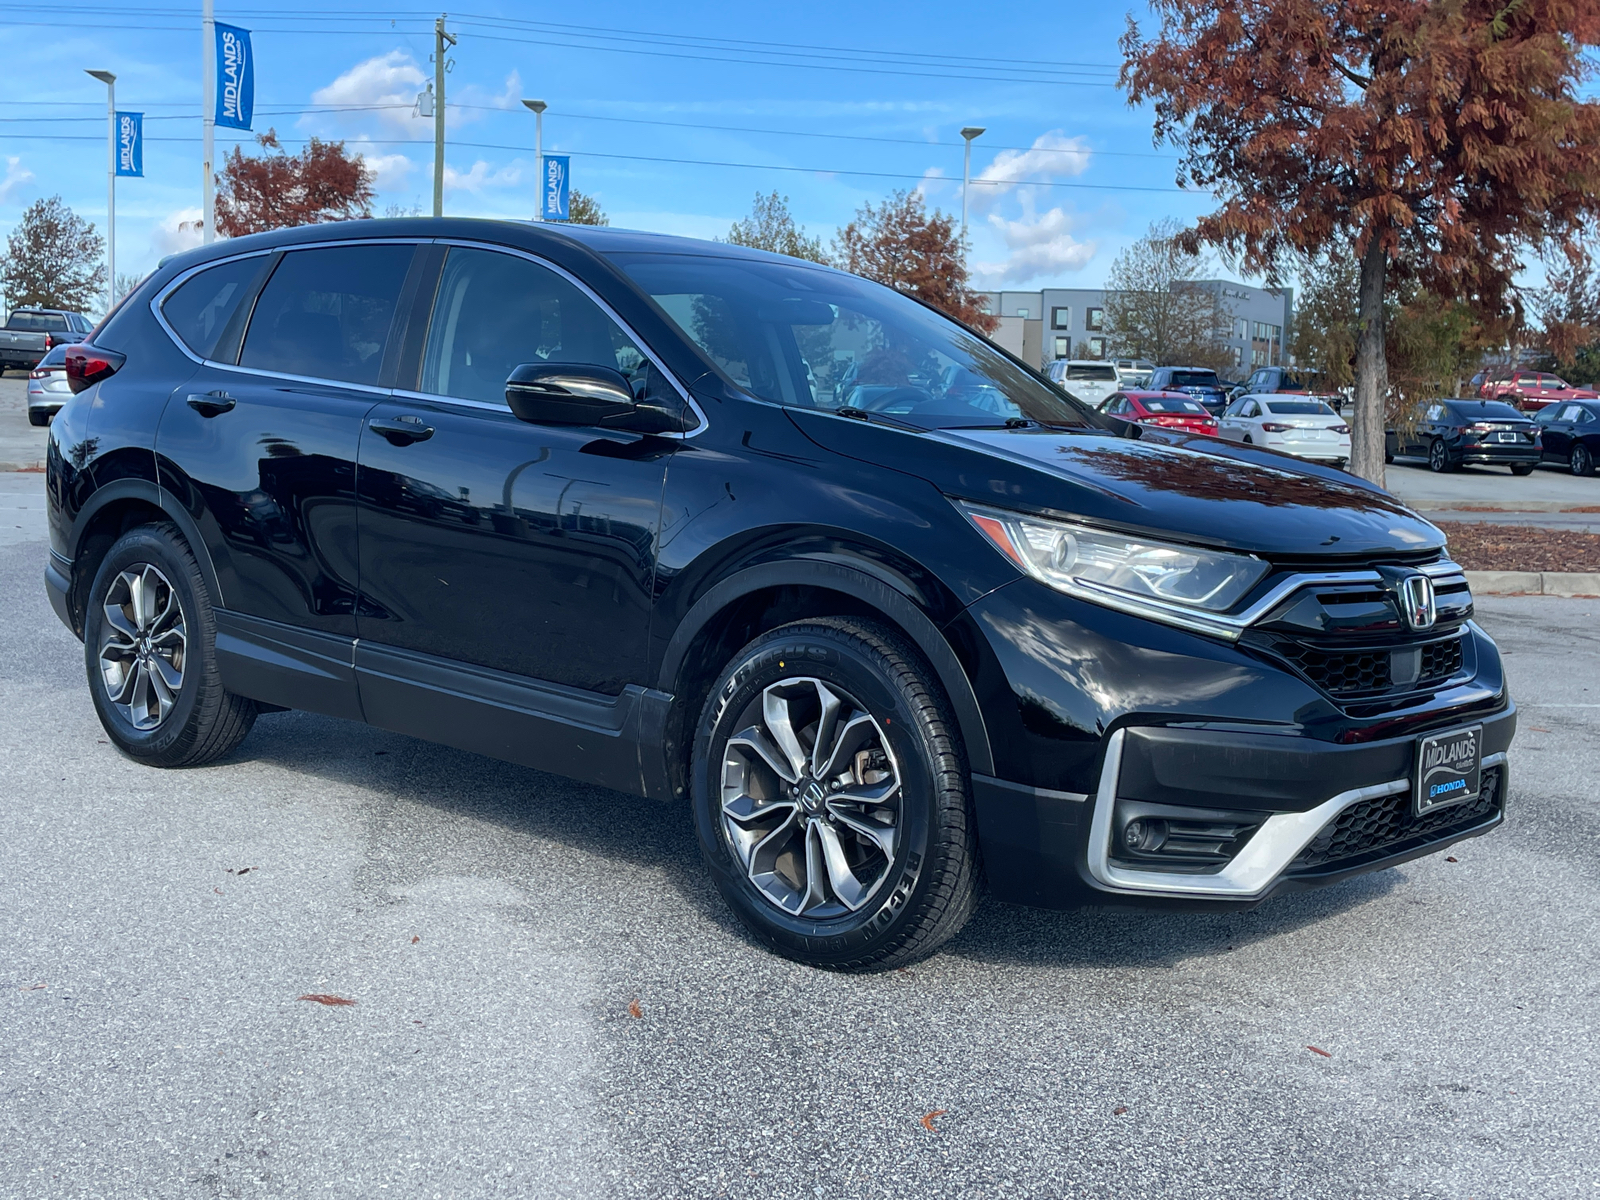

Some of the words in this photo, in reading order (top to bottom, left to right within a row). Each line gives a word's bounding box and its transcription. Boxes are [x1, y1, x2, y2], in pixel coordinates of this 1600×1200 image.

[222, 31, 237, 118] MIDLANDS
[121, 116, 130, 170] MIDLANDS
[548, 160, 558, 213] MIDLANDS
[1425, 738, 1476, 769] MIDLANDS
[1436, 779, 1466, 794] HONDA
[859, 850, 922, 942] RECON
